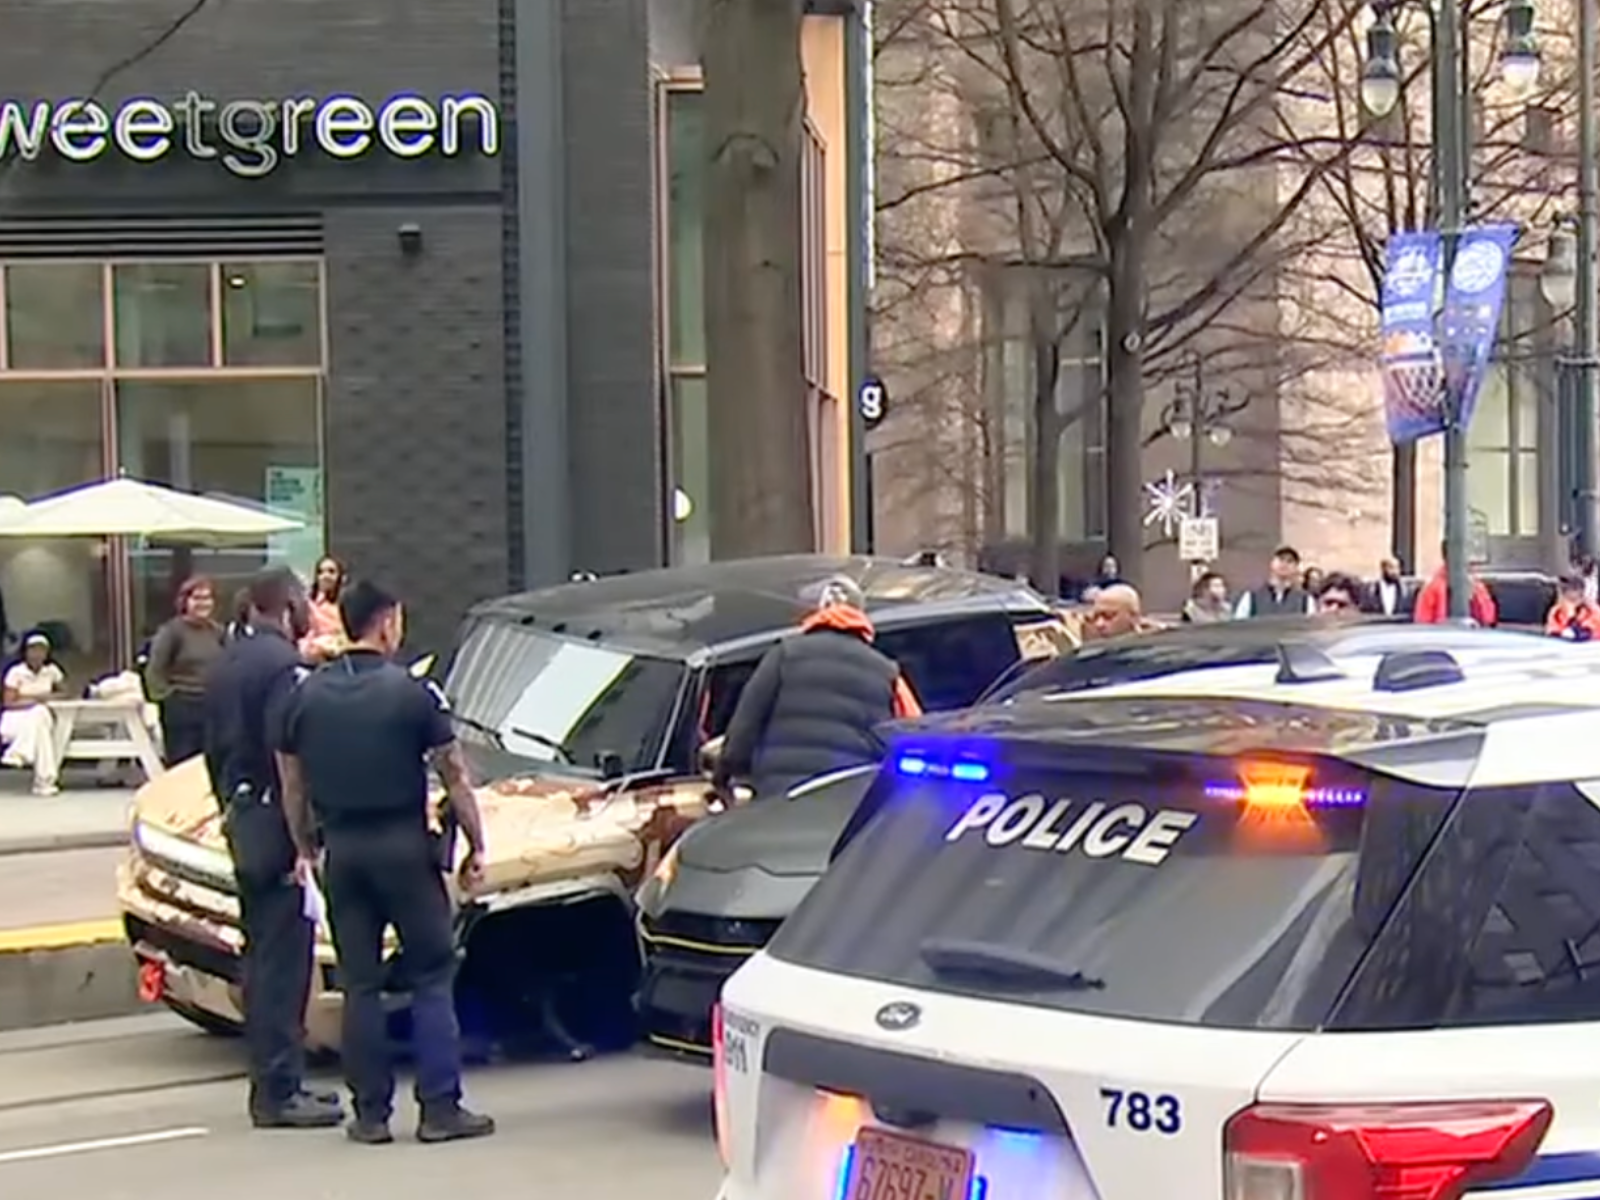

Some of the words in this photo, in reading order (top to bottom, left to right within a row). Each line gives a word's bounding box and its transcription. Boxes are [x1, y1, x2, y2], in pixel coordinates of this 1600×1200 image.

[862, 386, 881, 419] g
[946, 793, 1198, 865] POLICE
[1100, 1088, 1181, 1134] 783
